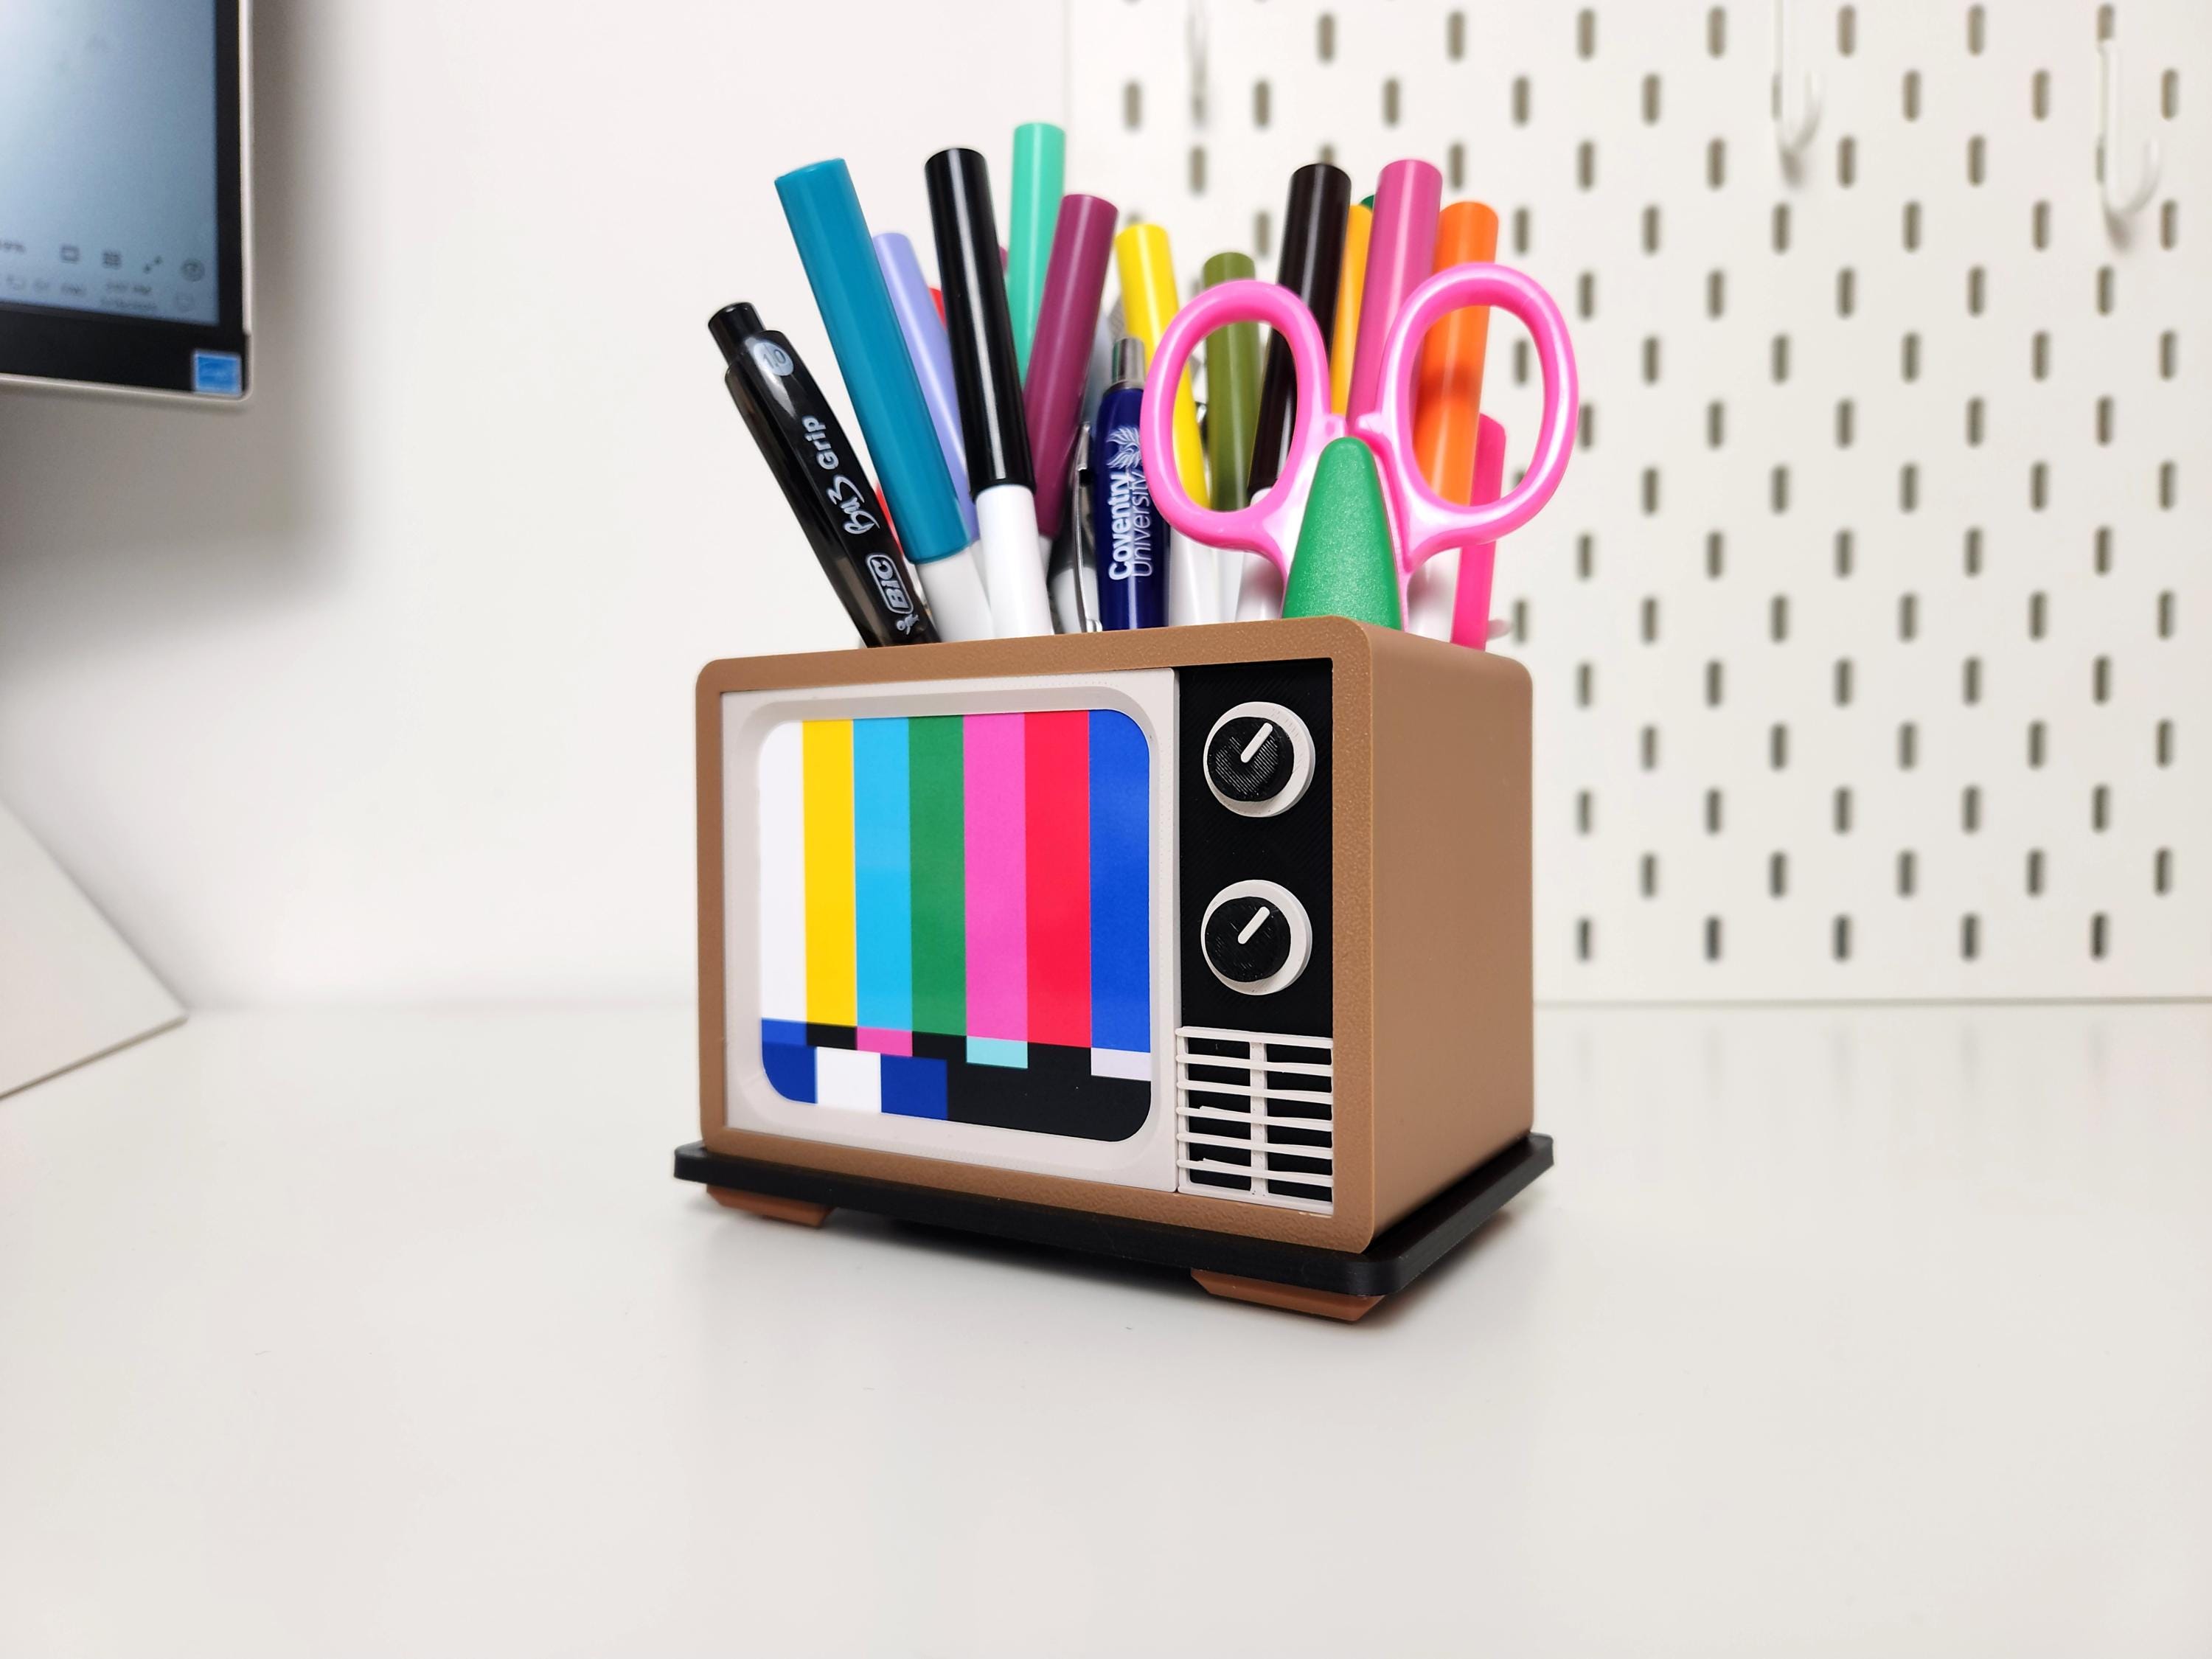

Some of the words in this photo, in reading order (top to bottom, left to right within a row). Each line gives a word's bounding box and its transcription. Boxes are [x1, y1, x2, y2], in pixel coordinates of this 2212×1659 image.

[803, 417, 839, 470] Grip
[1108, 473, 1135, 580] Coventry
[1130, 470, 1153, 577] University
[871, 559, 910, 609] BIC
